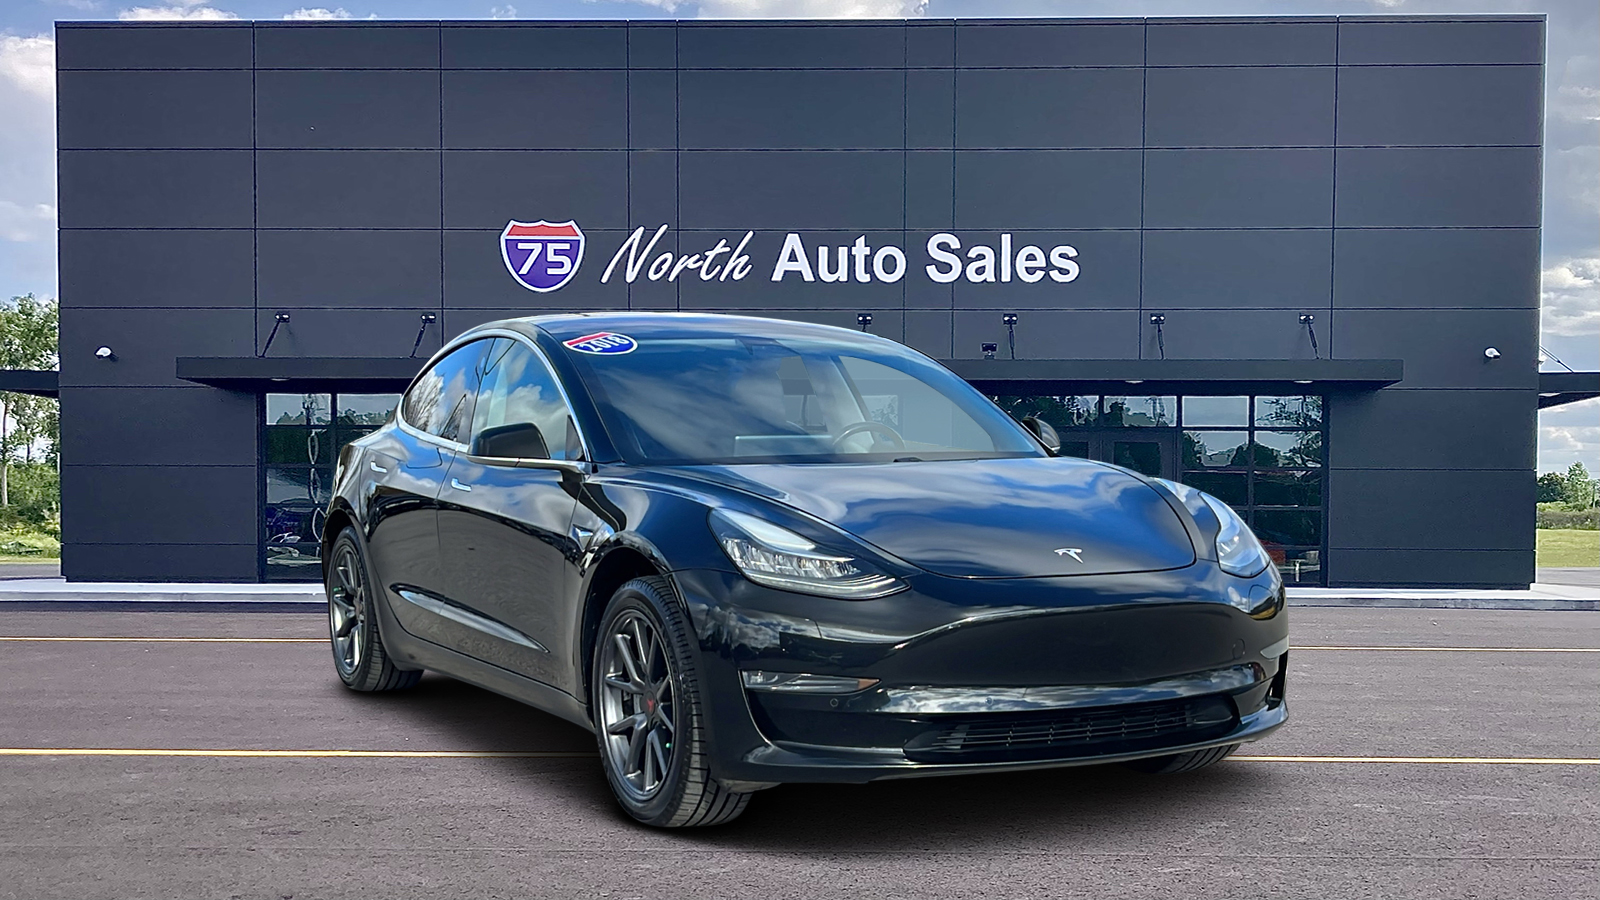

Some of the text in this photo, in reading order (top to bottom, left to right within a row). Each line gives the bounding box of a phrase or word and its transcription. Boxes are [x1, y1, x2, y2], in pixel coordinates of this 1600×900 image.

[516, 224, 1080, 285] 75 North Auto Sales
[579, 336, 630, 353] 2018
